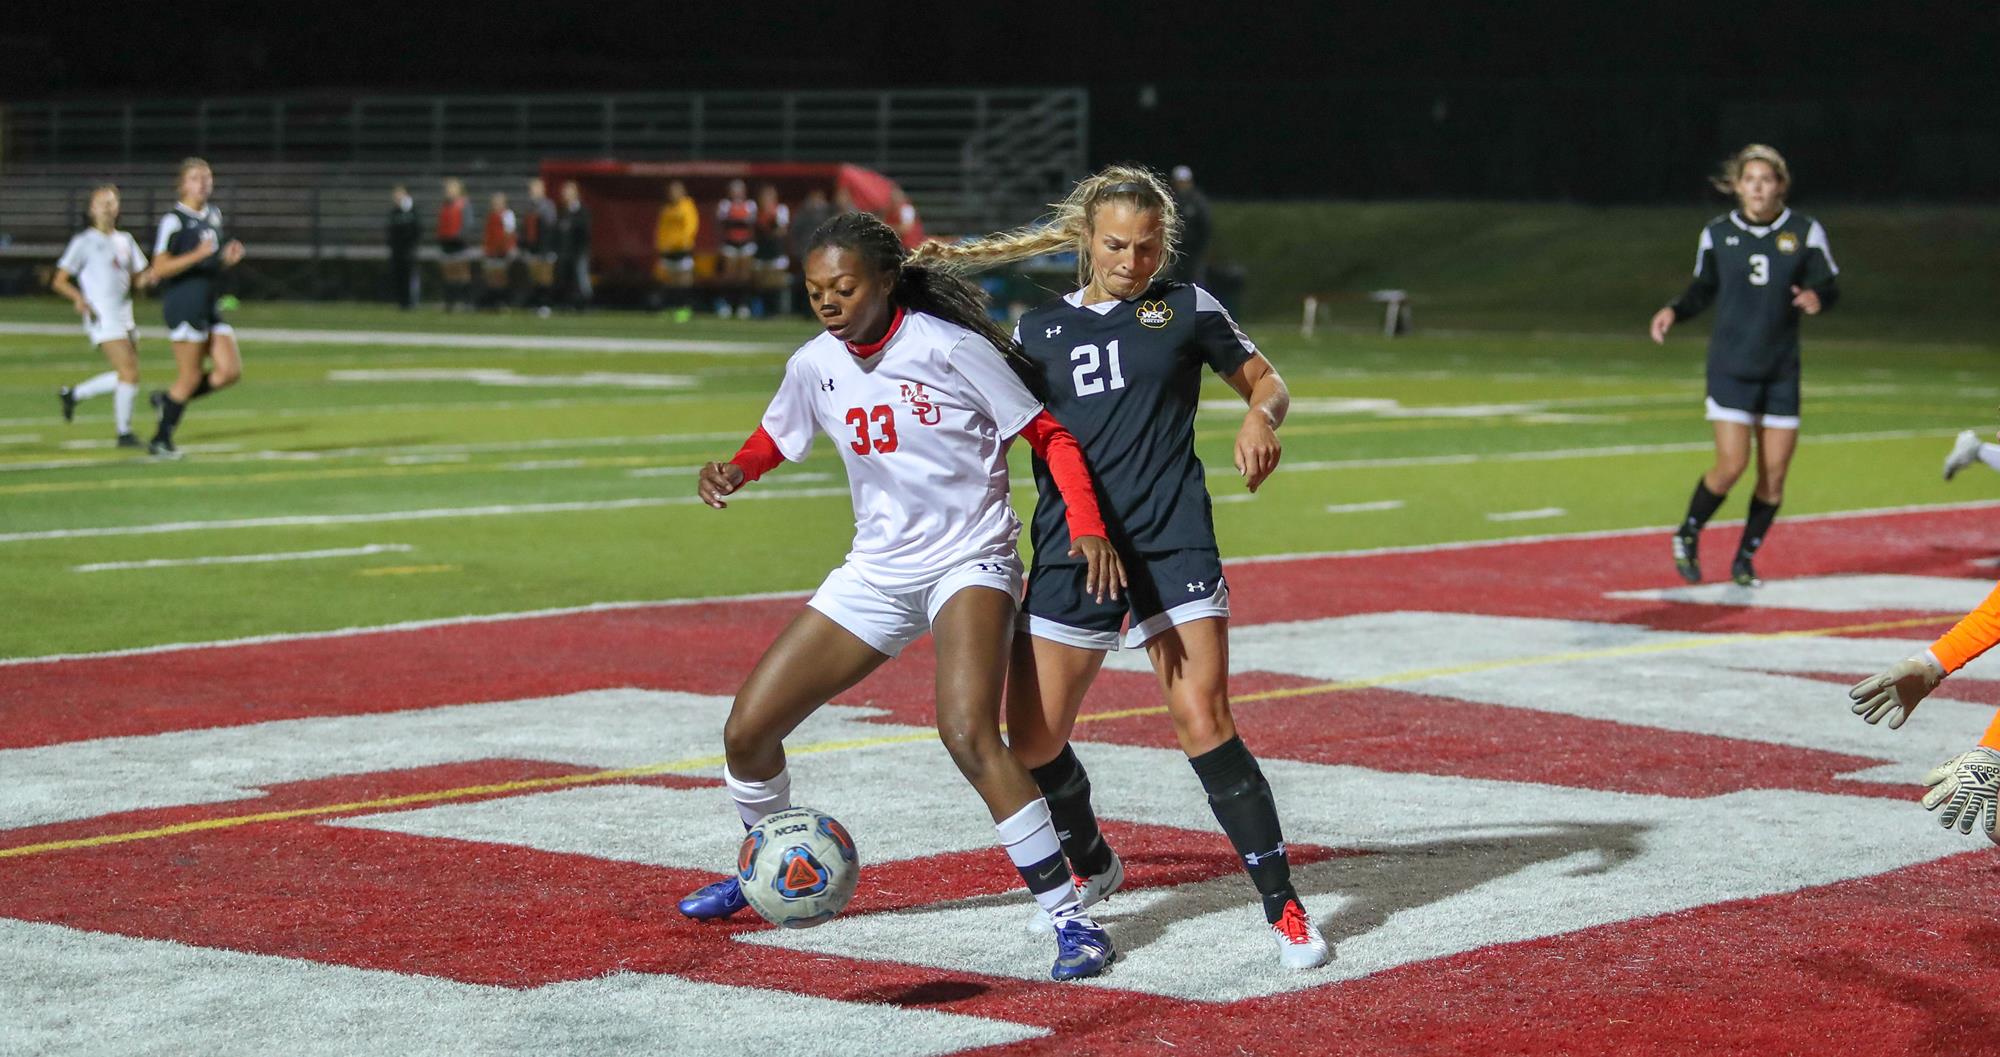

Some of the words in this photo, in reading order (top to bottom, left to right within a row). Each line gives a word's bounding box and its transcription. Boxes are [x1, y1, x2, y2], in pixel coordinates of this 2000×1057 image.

[1749, 254, 1769, 285] 3
[1140, 311, 1165, 319] WSC
[1070, 339, 1125, 397] 21
[899, 383, 941, 426] MSU
[845, 404, 898, 456] 33
[1963, 764, 2000, 775] adidas
[774, 824, 808, 838] NCAA
